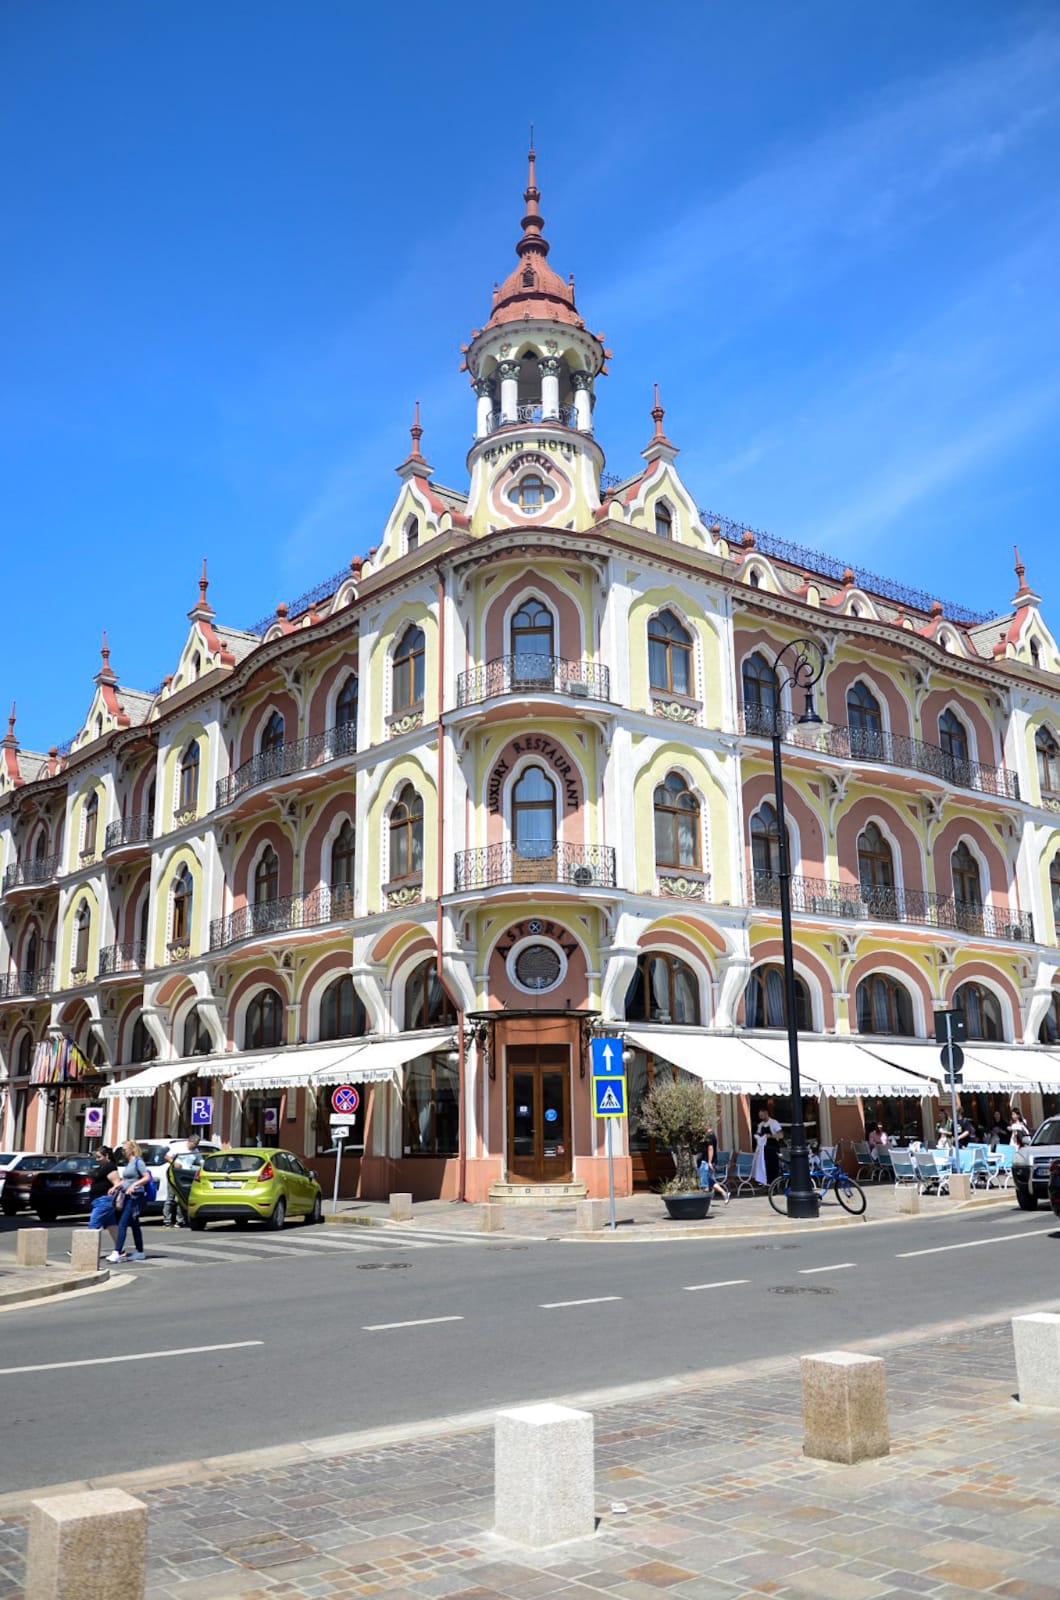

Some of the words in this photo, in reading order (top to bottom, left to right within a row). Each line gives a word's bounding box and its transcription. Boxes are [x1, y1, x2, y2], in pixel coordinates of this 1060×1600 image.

[484, 440, 524, 461] GRAND
[537, 439, 579, 455] HOTEL
[509, 454, 553, 474] ASTORIA
[489, 759, 509, 816] LUXURY
[512, 738, 579, 812] RESTAURANT
[194, 1100, 205, 1114] P
